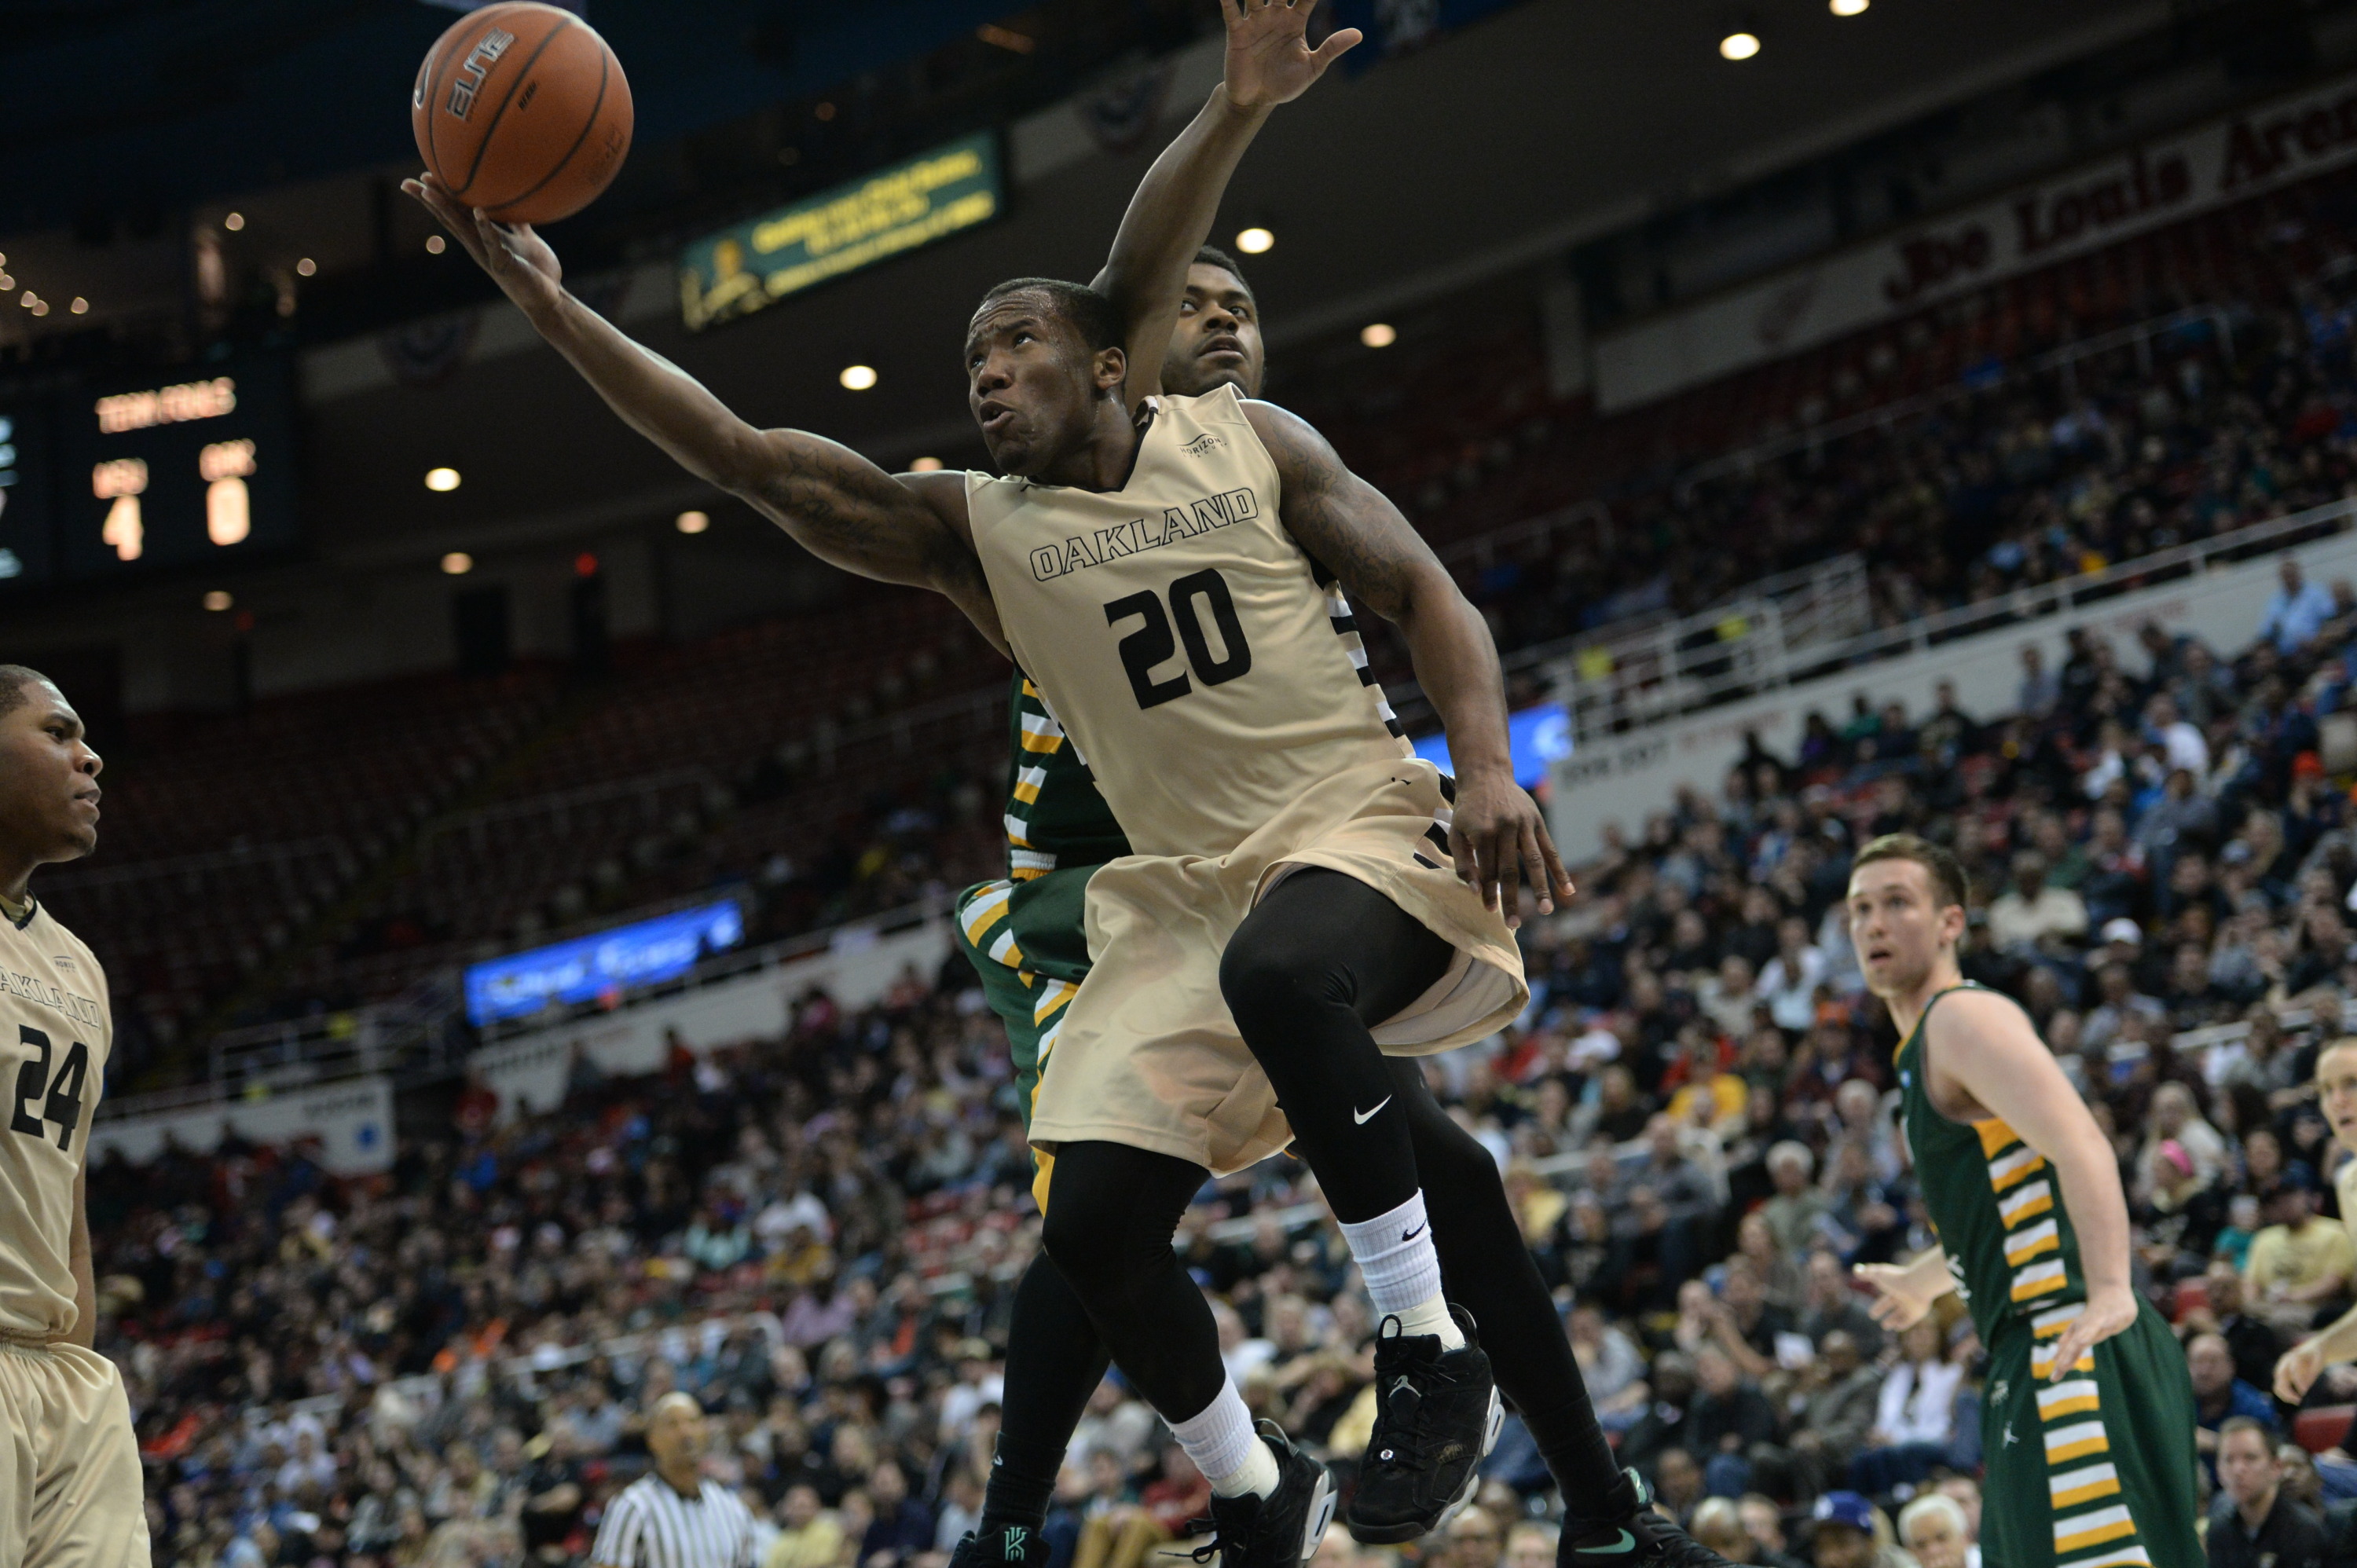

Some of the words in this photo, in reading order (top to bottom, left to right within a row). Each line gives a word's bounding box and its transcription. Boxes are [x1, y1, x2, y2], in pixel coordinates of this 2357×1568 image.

[445, 27, 515, 121] ELITE
[2016, 146, 2190, 255] Louis
[2220, 97, 2357, 192] Are
[1180, 438, 1222, 454] HORIZON
[1029, 487, 1259, 582] OAKLAND
[1103, 568, 1252, 710] 20
[0, 966, 101, 1030] AKLAND
[10, 1024, 89, 1152] 24
